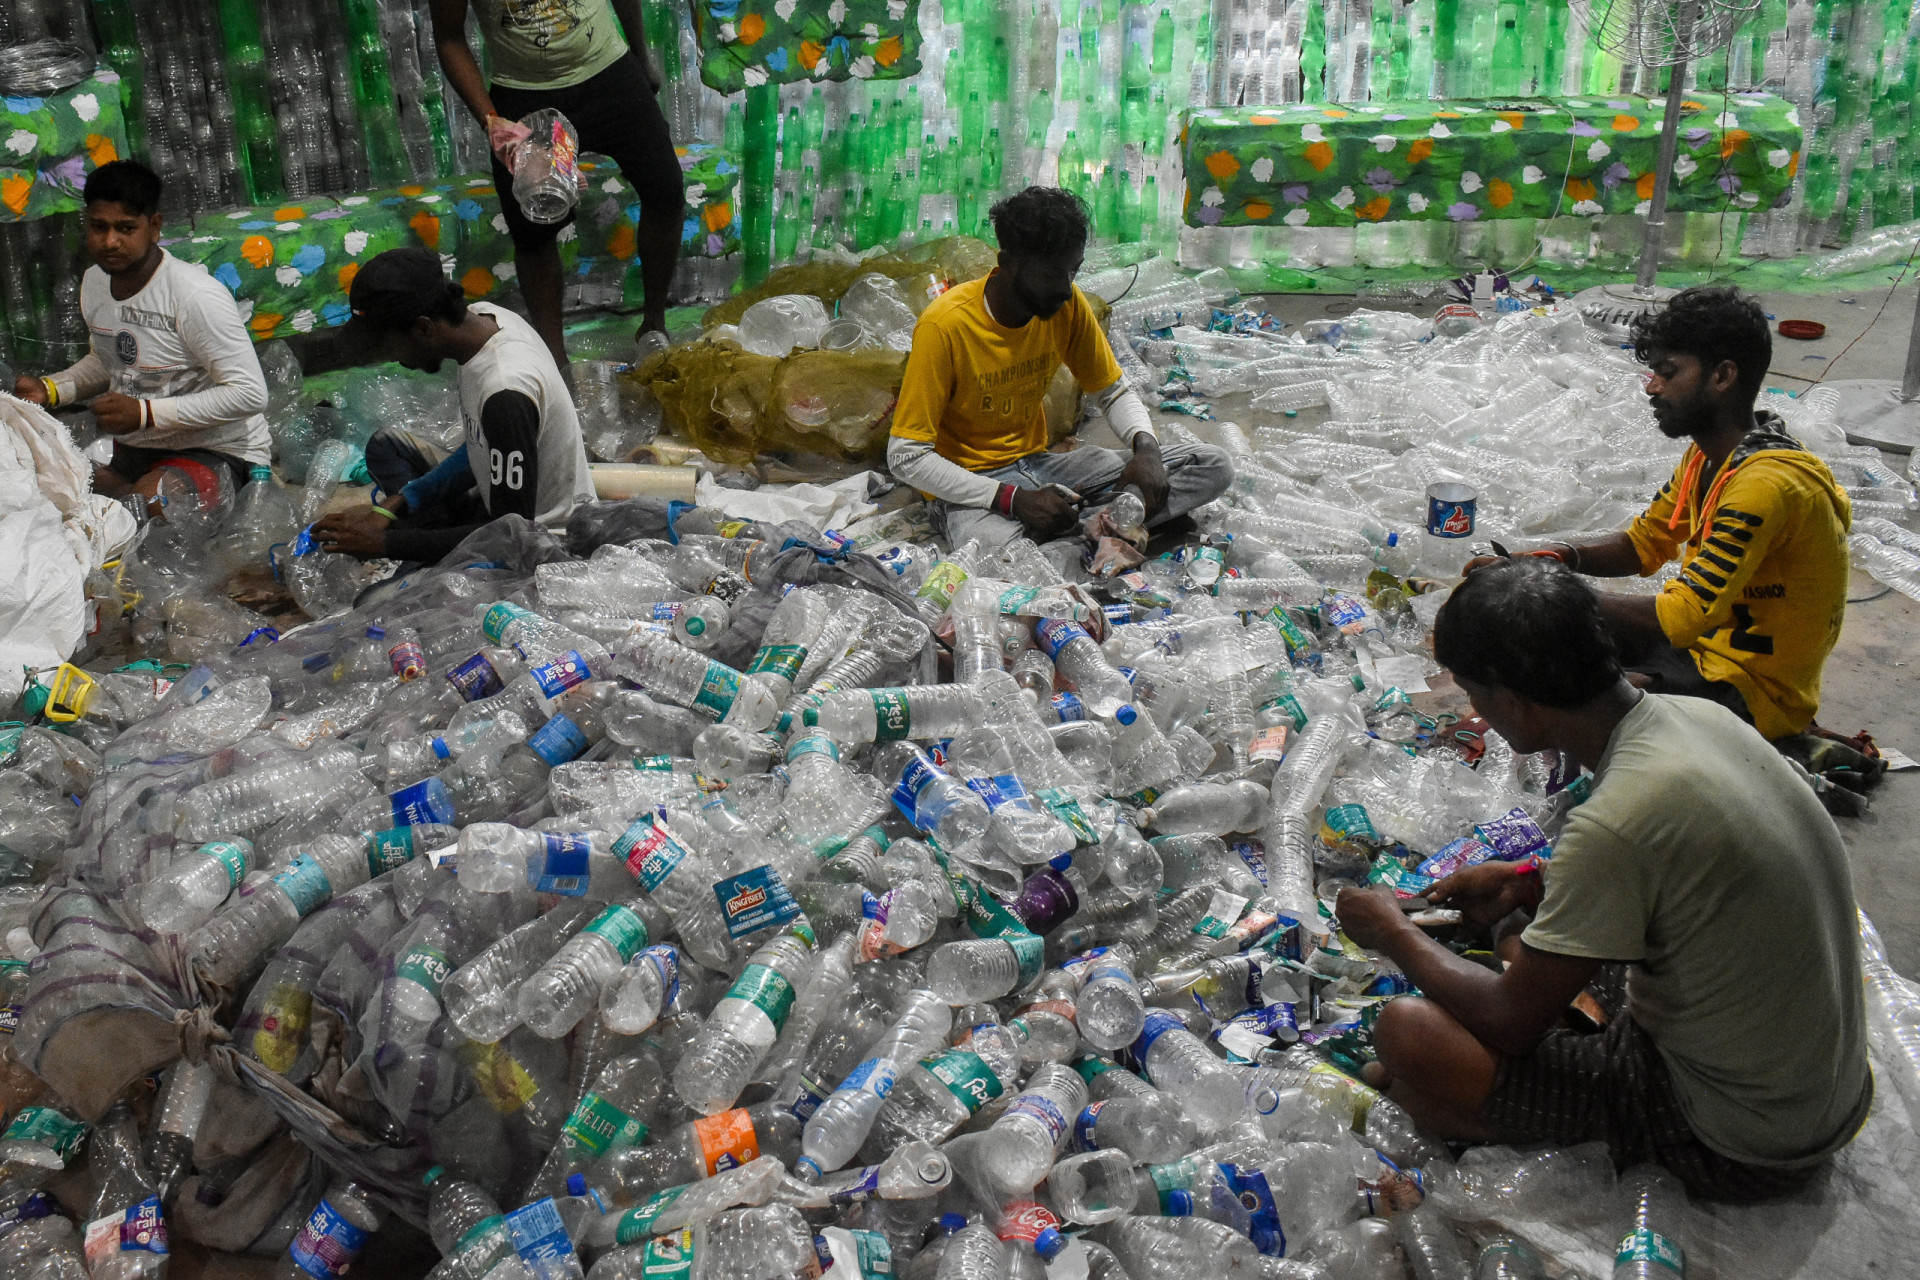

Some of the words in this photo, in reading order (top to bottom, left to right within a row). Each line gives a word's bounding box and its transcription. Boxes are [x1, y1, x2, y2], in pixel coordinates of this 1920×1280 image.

[490, 448, 524, 490] 96
[729, 891, 764, 912] KINGFISHER
[305, 1220, 324, 1242] neer
